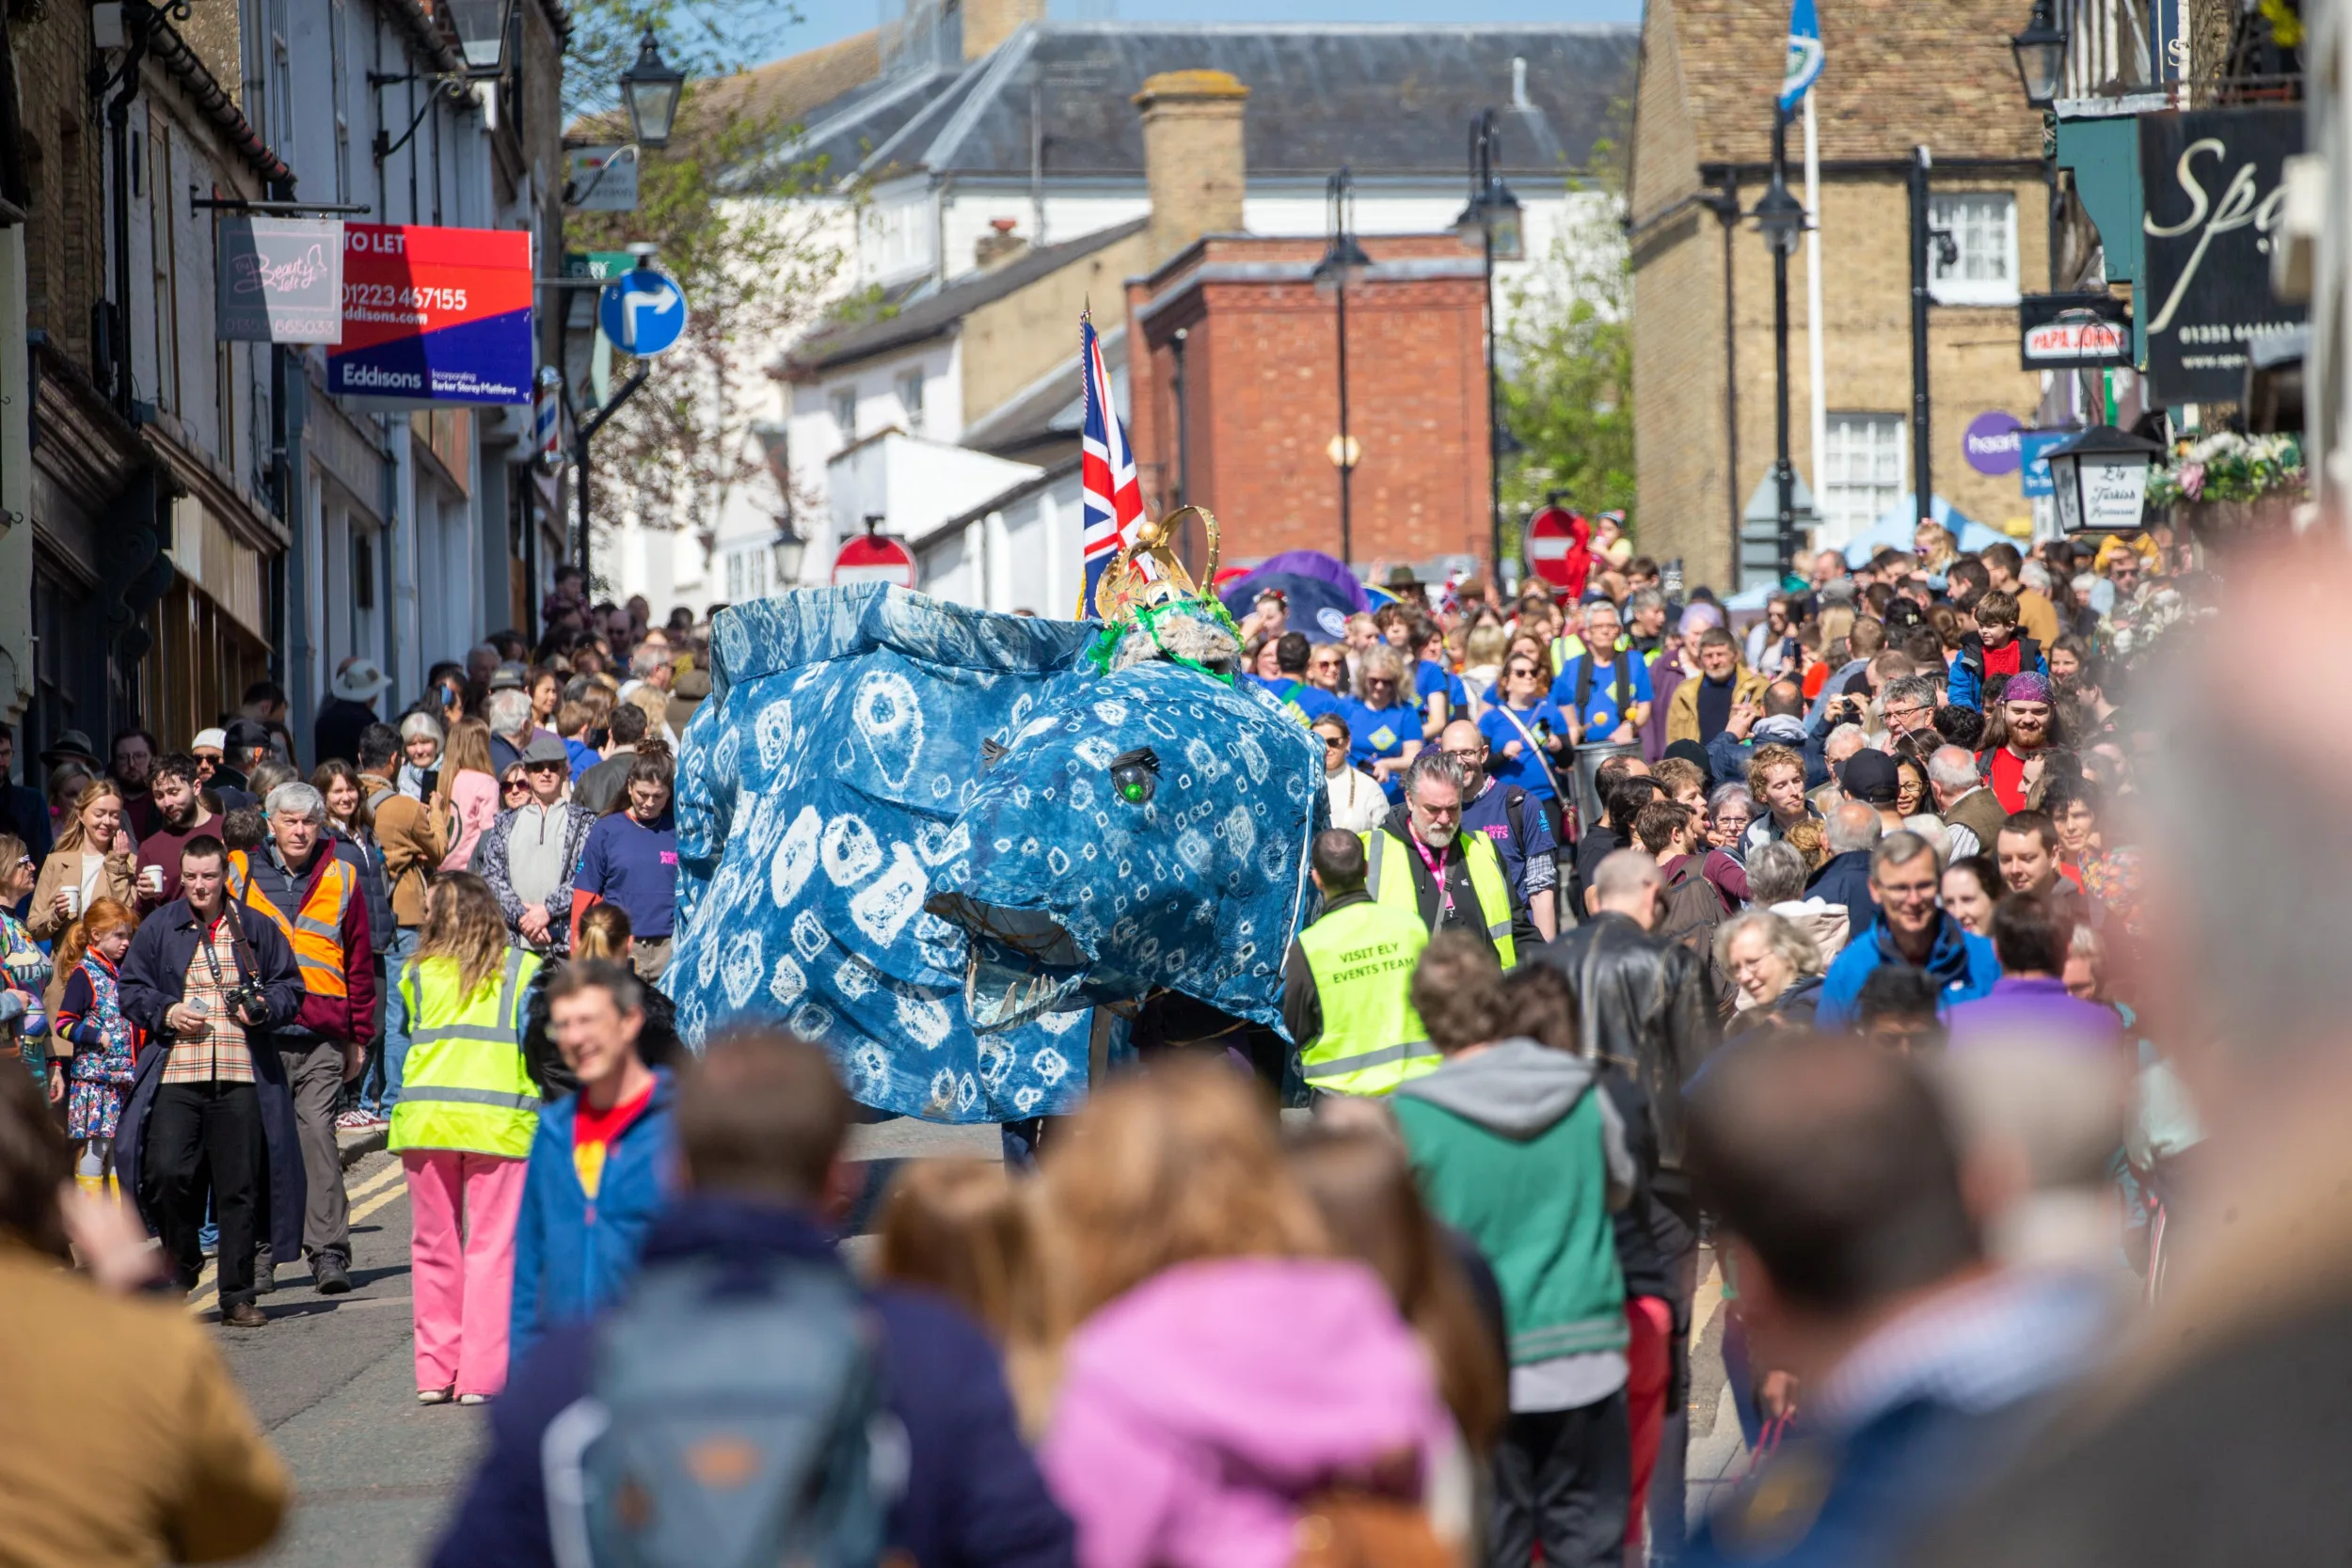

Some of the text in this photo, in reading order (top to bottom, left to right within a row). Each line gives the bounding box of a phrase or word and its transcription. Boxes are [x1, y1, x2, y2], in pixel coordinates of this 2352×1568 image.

[344, 231, 405, 254] TO LET
[232, 252, 313, 293] Beauty
[398, 286, 468, 310] 467155
[342, 305, 428, 325] ddisons.com
[2033, 329, 2069, 350] PAPA
[342, 363, 421, 389] Eddisons
[432, 368, 477, 382] Incorporating
[2099, 462, 2127, 483] Ely
[2090, 485, 2137, 506] Turkish
[2090, 506, 2137, 518] Restaurant
[1488, 831, 1509, 839] RTS
[661, 855, 677, 865] AR
[1340, 942, 1399, 963] VISIT ELY
[1332, 958, 1415, 984] EVENTS TEAM
